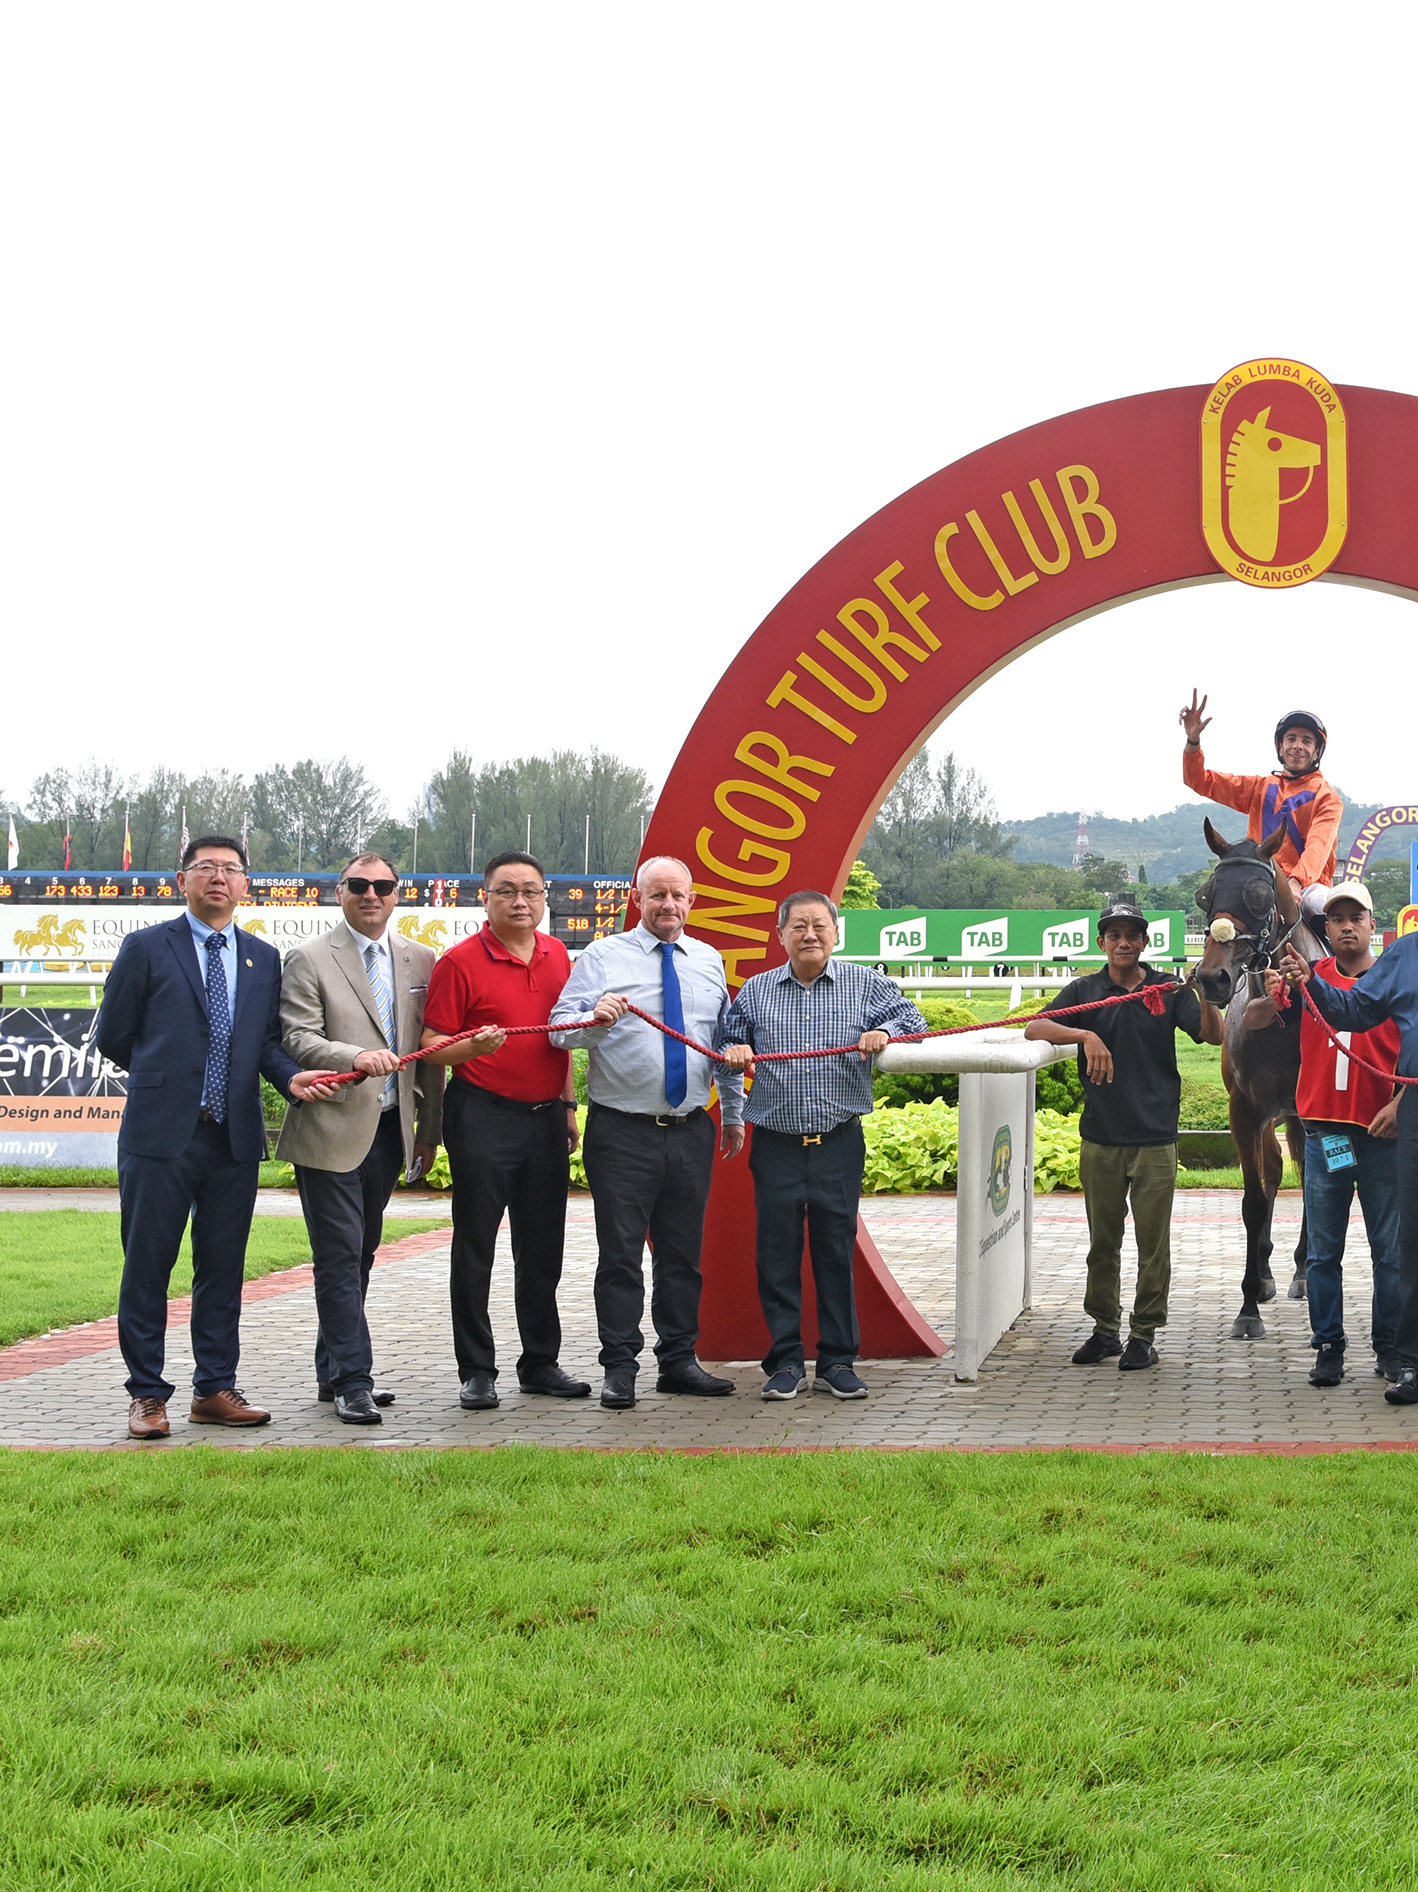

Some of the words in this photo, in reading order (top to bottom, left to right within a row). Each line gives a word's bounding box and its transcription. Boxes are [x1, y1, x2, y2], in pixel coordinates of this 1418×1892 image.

[1209, 374, 1243, 414] KELAB
[1248, 364, 1301, 381] LUMBA
[1305, 377, 1337, 414] KUDA
[1236, 562, 1313, 583] SELANGOR
[685, 730, 835, 989] ANGOR
[765, 559, 942, 745] TURF
[934, 464, 1117, 611] CLUB
[25, 876, 31, 885] 4
[52, 877, 58, 885] 5
[79, 877, 86, 885] 6
[105, 877, 112, 885] 7
[132, 877, 139, 885] 8
[159, 877, 166, 885] 9
[252, 878, 305, 887] MESSAGES
[593, 880, 632, 889] OFFICIA
[45, 885, 66, 897] 173
[70, 885, 93, 897] 433
[98, 885, 119, 897] 123
[131, 885, 146, 897] 13
[156, 885, 173, 897] 78
[270, 886, 298, 898] RACE
[305, 886, 319, 898] 10
[404, 887, 419, 899] 12
[449, 887, 458, 899] 6
[568, 888, 583, 900] 39
[595, 888, 615, 900] 1/2
[567, 918, 589, 931] 518
[595, 916, 615, 928] 1/2
[885, 931, 921, 947] TAB
[966, 931, 1003, 947] TAB
[1047, 932, 1084, 947] TAB
[1328, 1031, 1352, 1091] 1
[53, 1106, 83, 1119] and
[87, 1107, 124, 1119] Man
